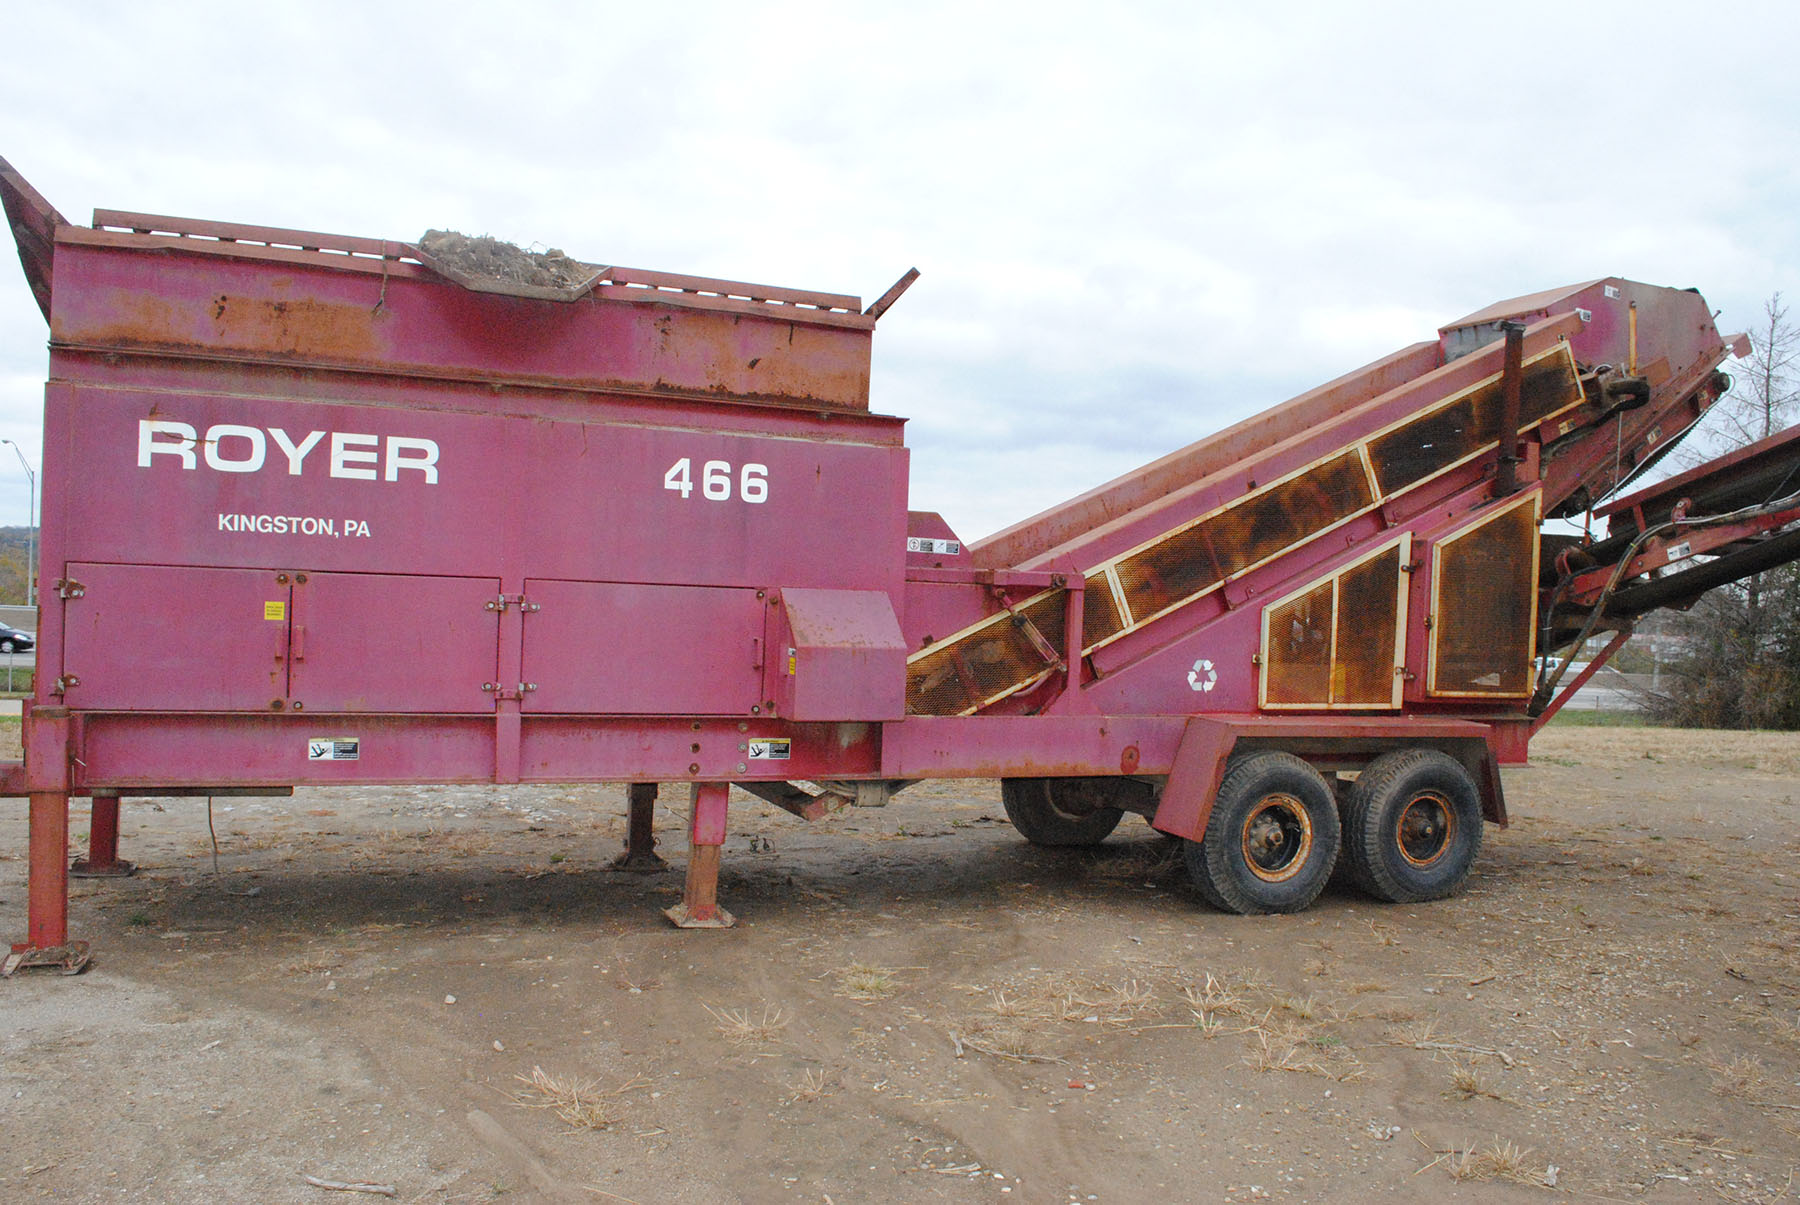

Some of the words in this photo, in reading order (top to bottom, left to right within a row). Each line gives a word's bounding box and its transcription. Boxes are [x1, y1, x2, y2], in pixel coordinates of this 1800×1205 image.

[137, 419, 440, 485] ROYER
[664, 457, 768, 504] 466
[218, 513, 340, 538] KINGSTON,
[343, 519, 372, 537] PA
